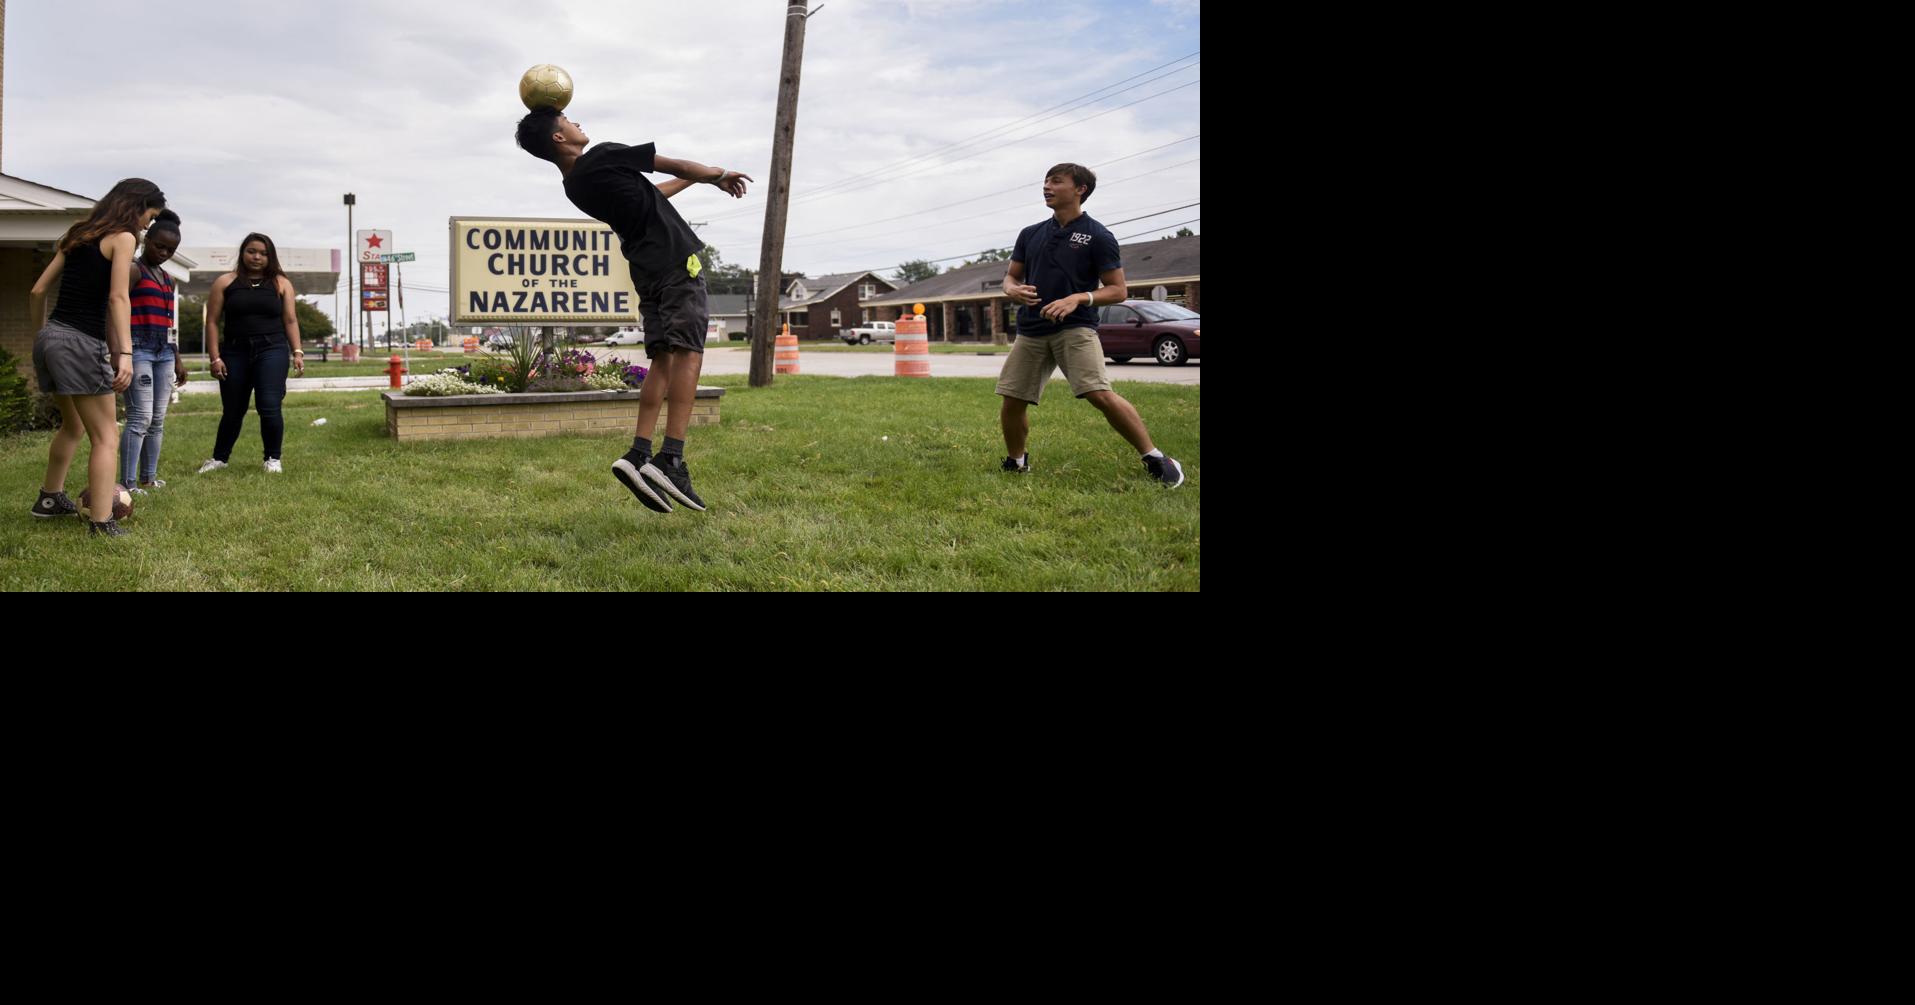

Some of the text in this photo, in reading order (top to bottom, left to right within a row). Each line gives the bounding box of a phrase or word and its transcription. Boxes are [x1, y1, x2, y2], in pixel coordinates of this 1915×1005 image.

[466, 228, 614, 251] COMMUNIT
[1070, 232, 1092, 245] 1922
[362, 250, 380, 260] STA
[487, 253, 609, 276] CHURCH
[522, 279, 578, 288] OF THE
[469, 291, 630, 313] NAZARENE
